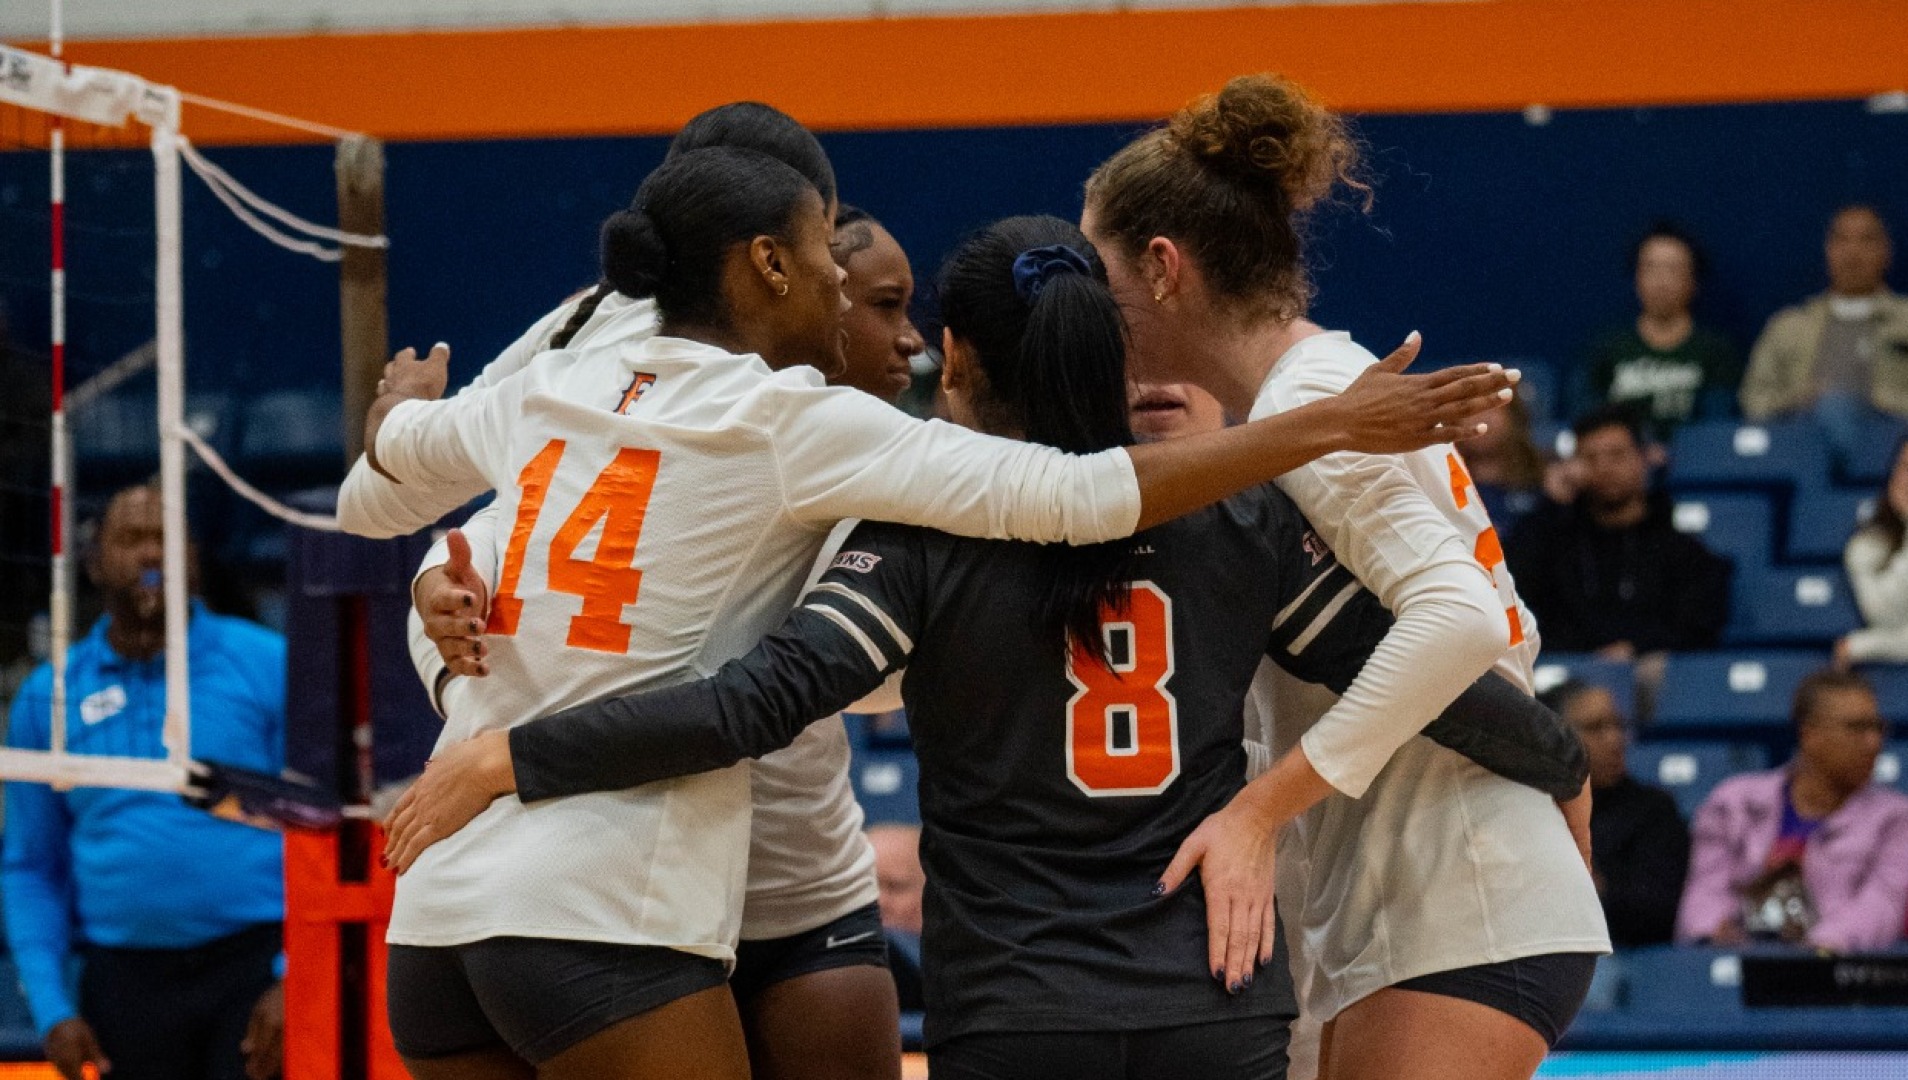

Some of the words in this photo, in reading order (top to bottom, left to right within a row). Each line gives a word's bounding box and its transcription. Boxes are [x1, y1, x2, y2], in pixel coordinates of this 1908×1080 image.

[612, 370, 657, 416] F
[484, 438, 661, 655] 14
[1065, 580, 1180, 797] 8
